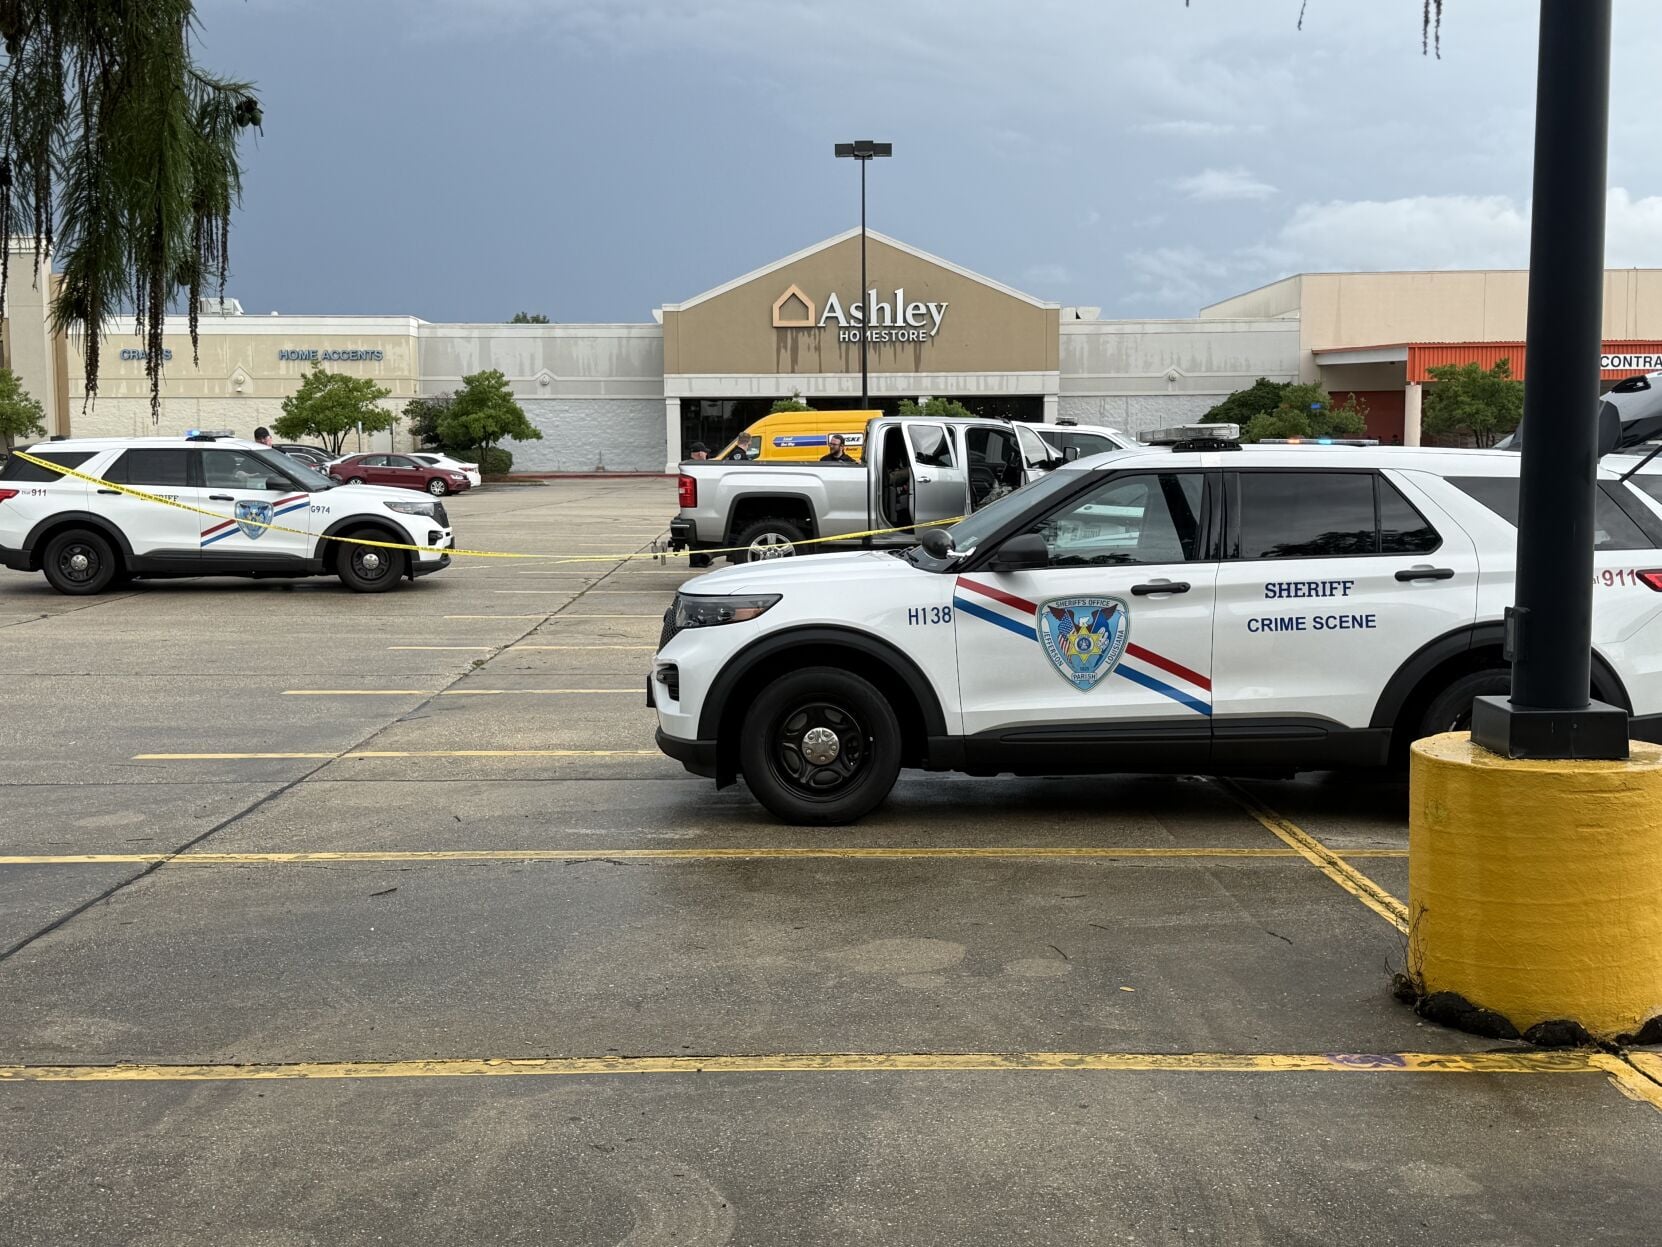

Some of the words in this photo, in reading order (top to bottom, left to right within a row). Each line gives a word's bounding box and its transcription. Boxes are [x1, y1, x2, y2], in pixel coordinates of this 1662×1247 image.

[817, 288, 949, 336] Ashley
[120, 349, 172, 360] CRAS
[279, 350, 318, 360] HOME
[321, 350, 384, 360] ACCENTS
[310, 505, 330, 514] G974
[1602, 568, 1636, 587] 911
[1264, 580, 1354, 599] SHERIFF
[1055, 600, 1087, 608] SHERIFF'S
[908, 605, 952, 625] H138
[1247, 616, 1307, 632] CRIME
[1312, 614, 1377, 630] SCENE
[1043, 631, 1064, 667] JEFFERSON
[1105, 630, 1124, 665] LOUISIANA
